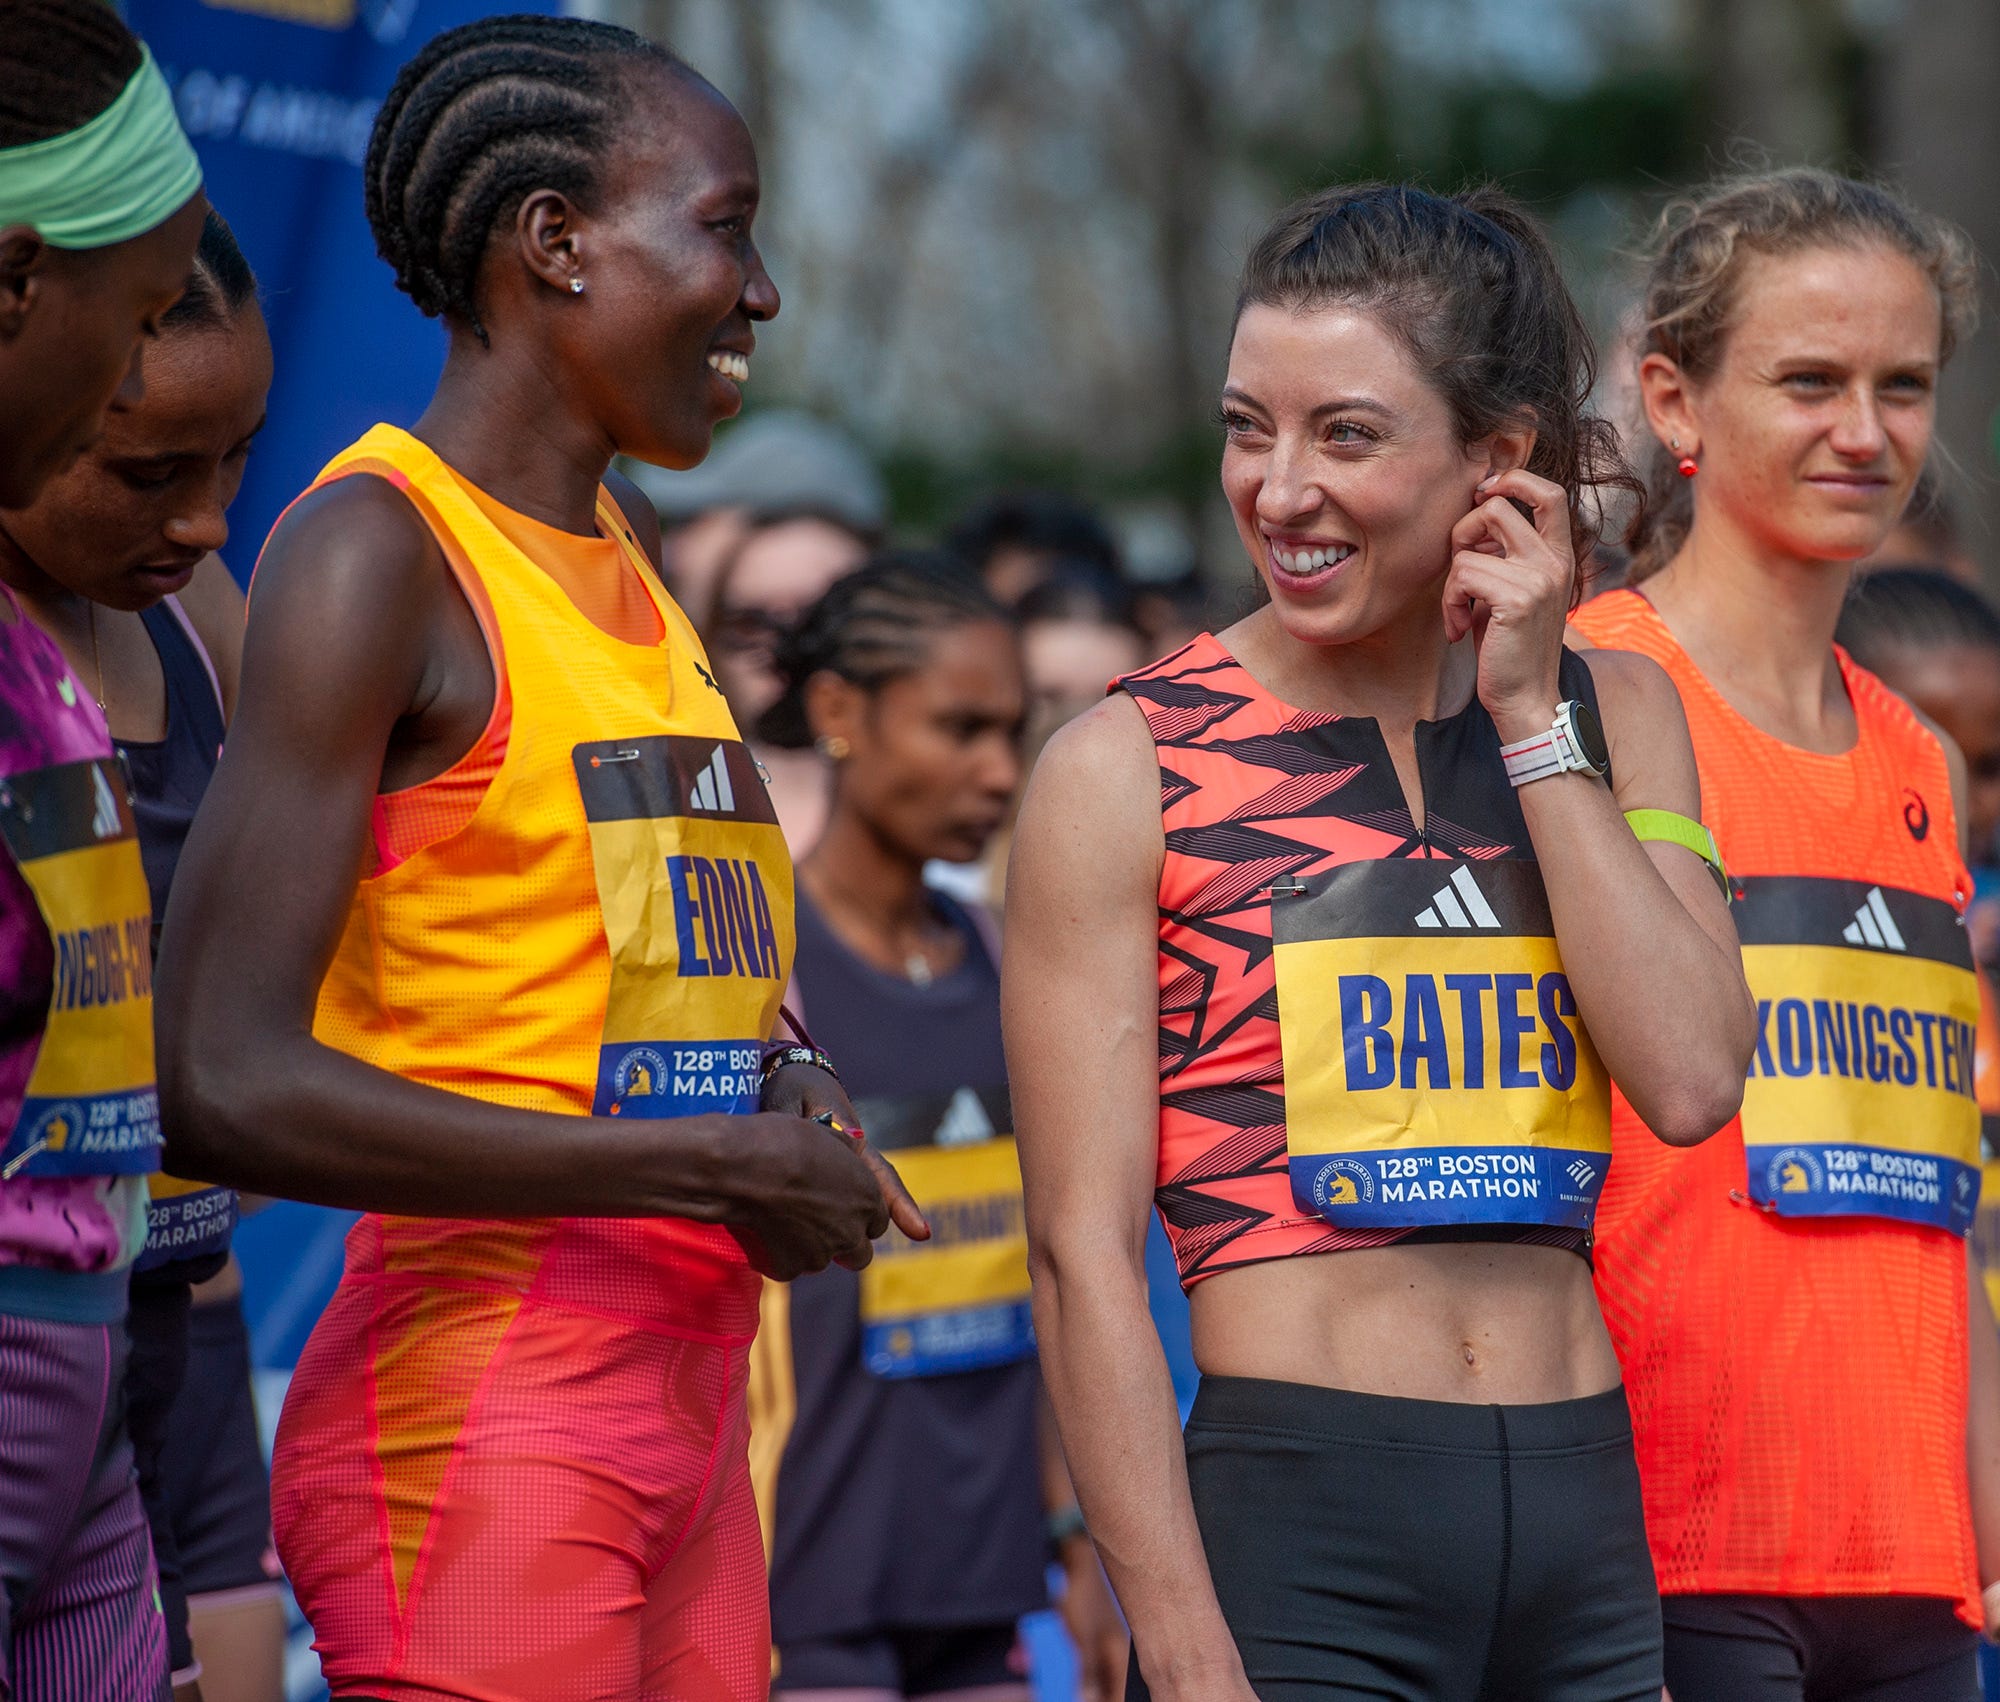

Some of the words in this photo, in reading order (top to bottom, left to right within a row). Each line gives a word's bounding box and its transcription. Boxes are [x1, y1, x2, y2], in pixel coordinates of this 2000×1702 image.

[666, 855, 781, 980] EDNA
[1338, 972, 1577, 1092] BATES
[673, 1050, 726, 1071] 128TH
[1318, 1161, 1344, 1182] BOSTON
[1348, 1161, 1372, 1199] MARATHON
[1377, 1157, 1432, 1179] 128TH
[1438, 1155, 1536, 1176] BOSTON
[1823, 1150, 1869, 1172] 128TH
[1870, 1152, 1938, 1182] BOSTON
[1828, 1172, 1940, 1204] MARATHON
[183, 1189, 232, 1221] BOSTON
